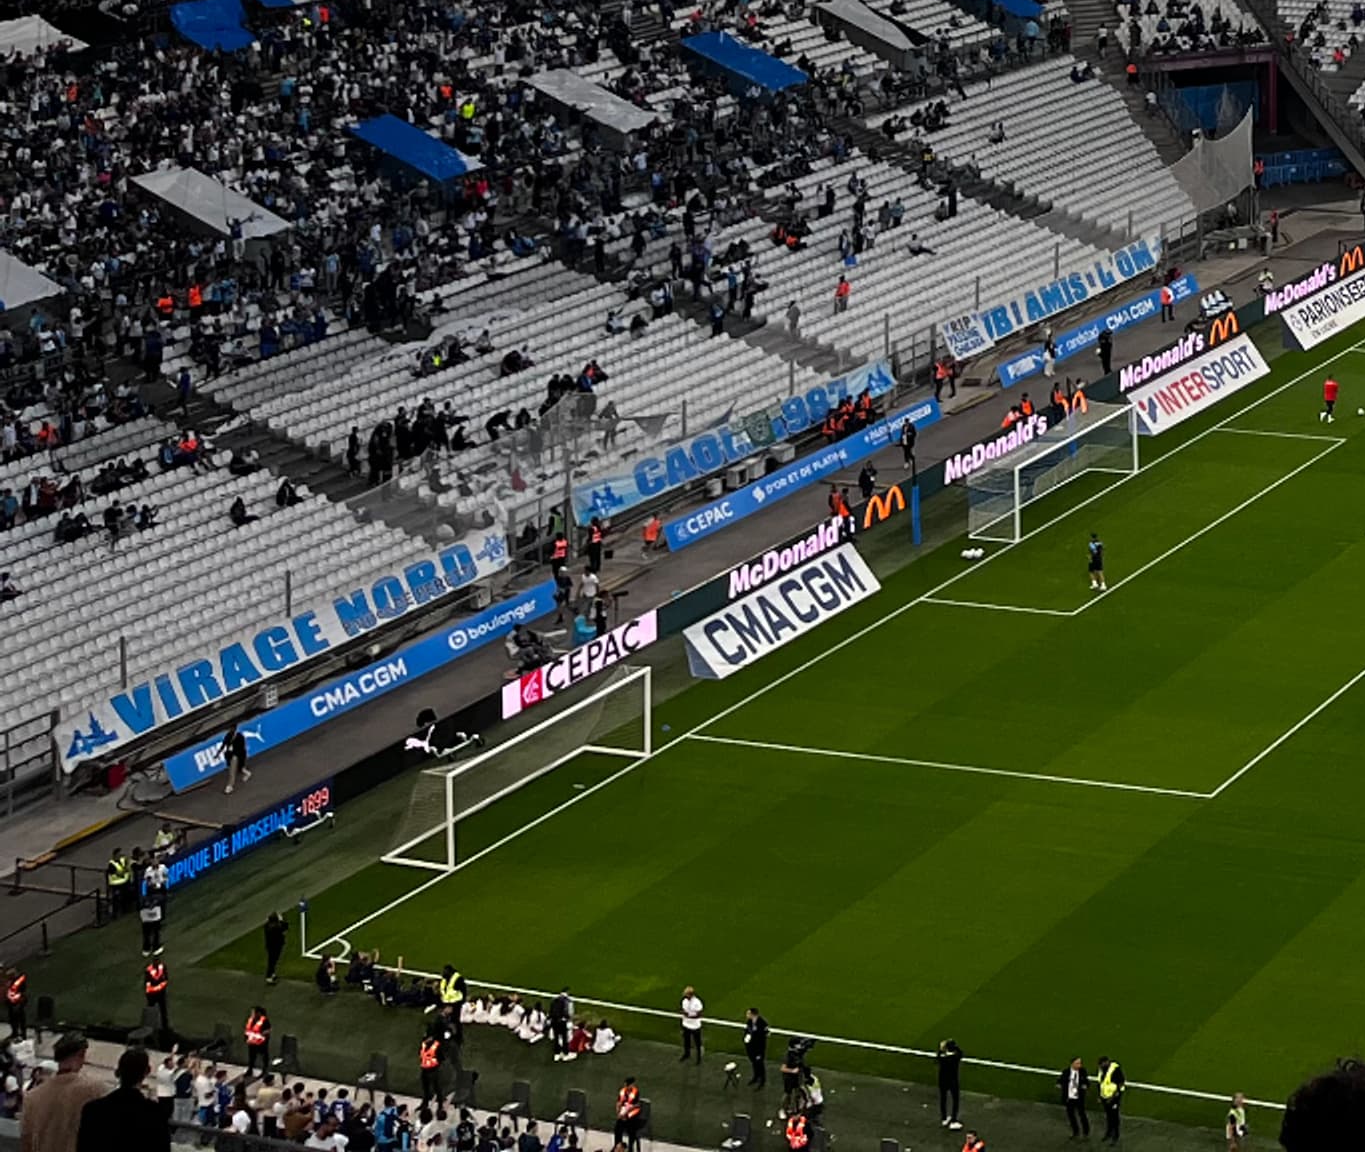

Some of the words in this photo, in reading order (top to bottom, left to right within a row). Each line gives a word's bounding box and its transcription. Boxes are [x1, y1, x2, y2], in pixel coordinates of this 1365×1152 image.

[1024, 272, 1088, 322] AMIS
[1095, 239, 1155, 289] L'OM
[1264, 262, 1336, 315] McDonald's
[1120, 332, 1204, 391] McDonald's
[1154, 345, 1257, 416] INTERSPORT
[943, 414, 1047, 485] McDonald's
[687, 501, 734, 535] CEPAC
[110, 610, 330, 735] VIRAGE
[332, 543, 479, 637] NORD
[467, 599, 537, 640] boulanger
[703, 591, 795, 666] CMA
[778, 552, 867, 626] CGM
[310, 684, 357, 717] CMA
[358, 658, 408, 693] CGM
[545, 620, 641, 692] CEPAC
[213, 838, 230, 864] DE
[301, 786, 331, 818] 1899
